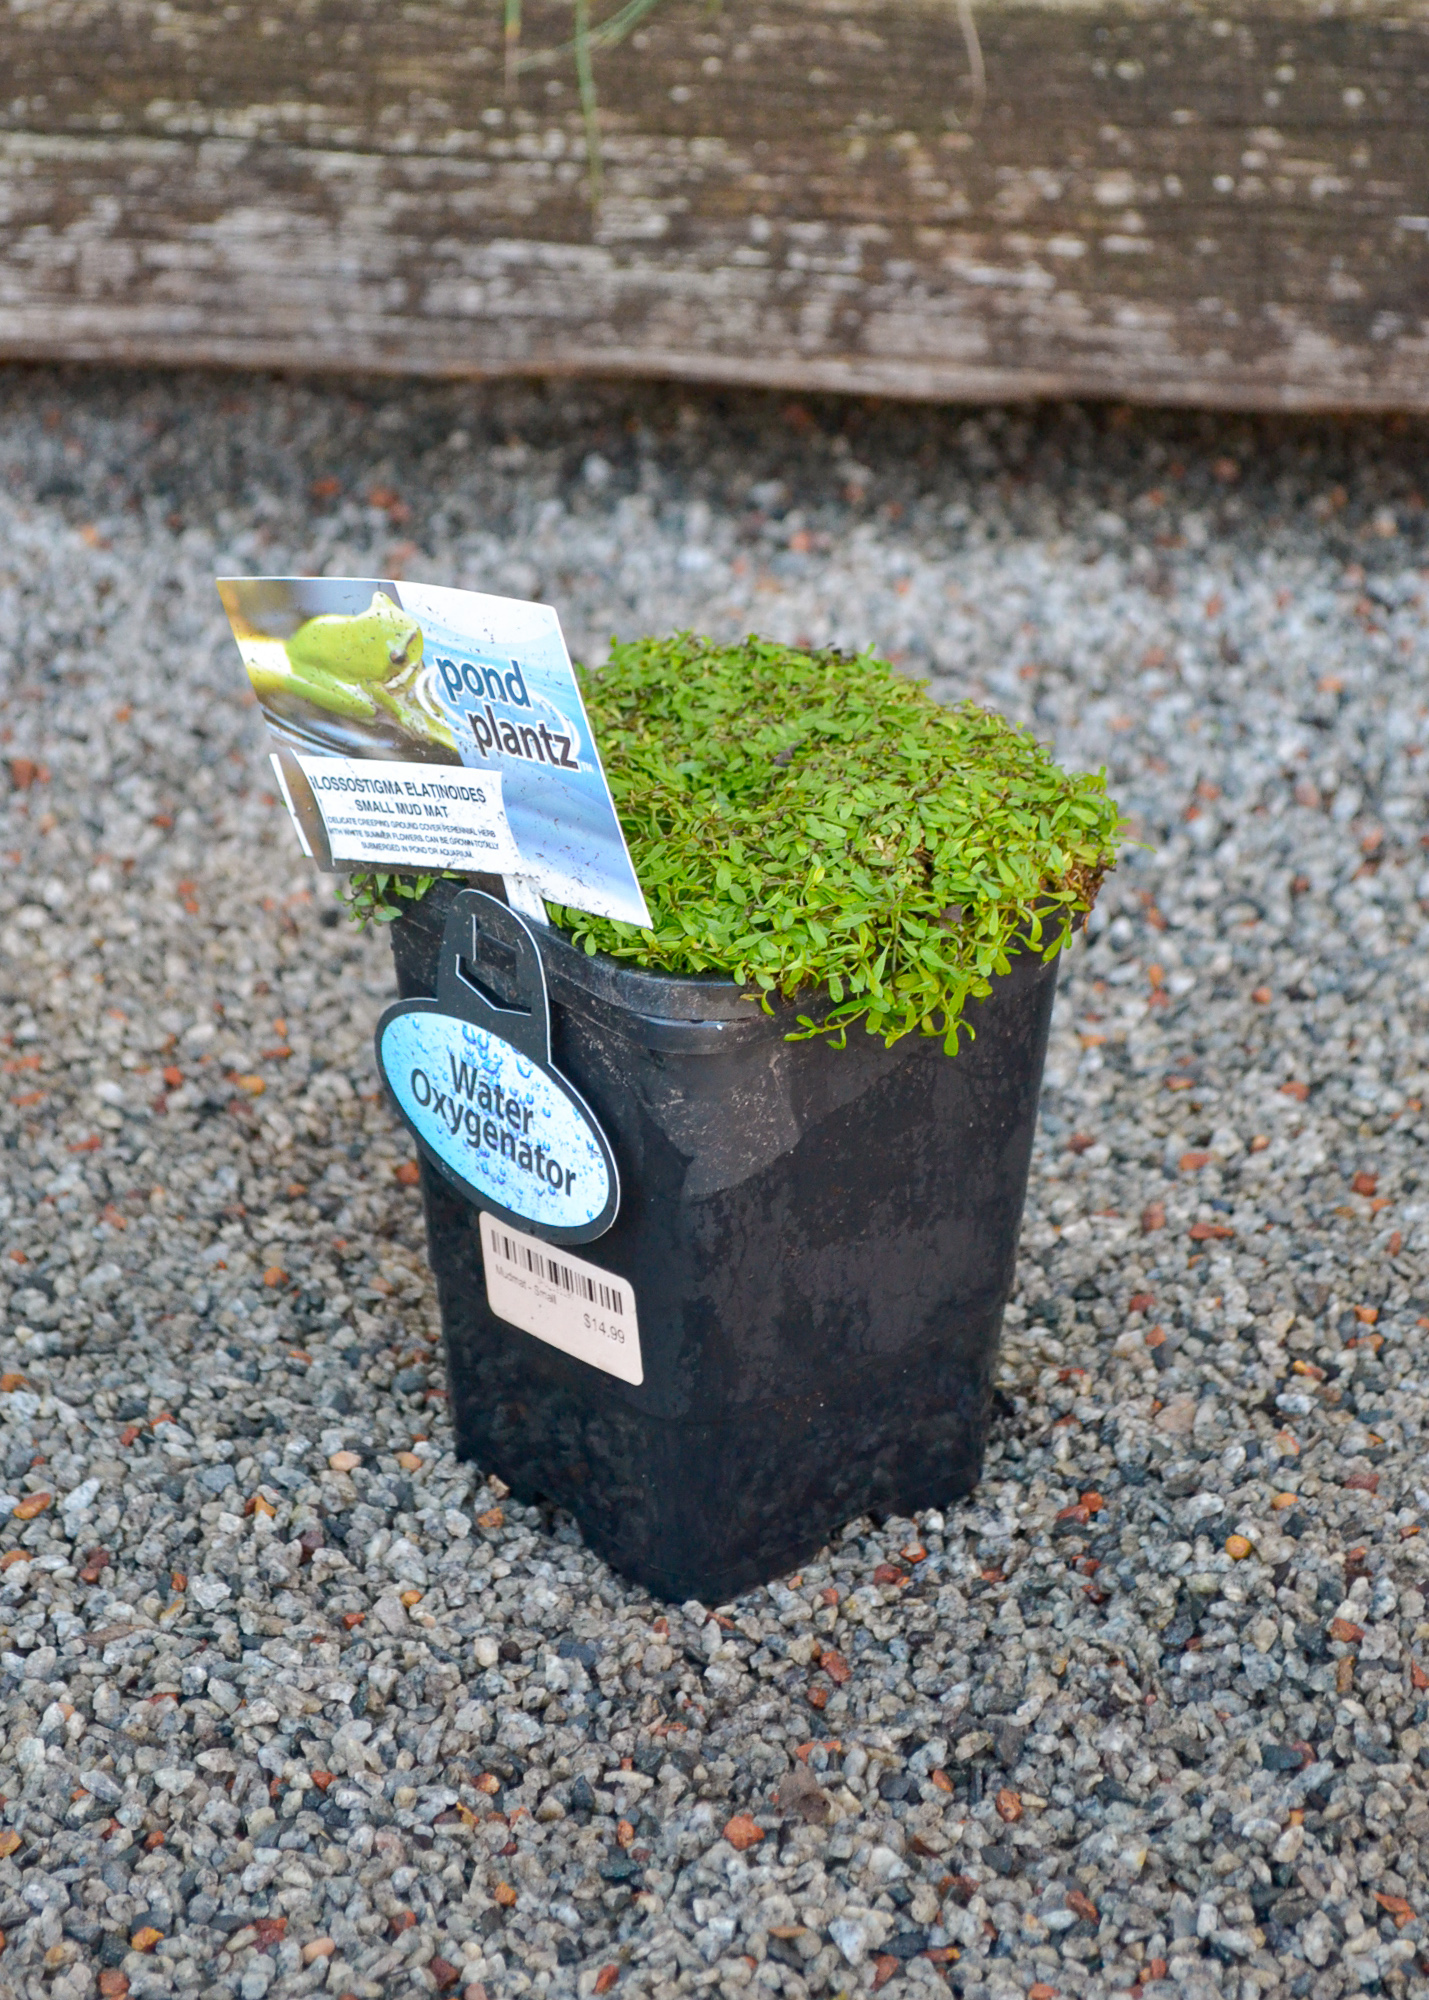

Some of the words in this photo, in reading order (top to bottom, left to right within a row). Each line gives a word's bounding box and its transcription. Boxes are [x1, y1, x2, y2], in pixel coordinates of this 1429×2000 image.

[435, 657, 532, 708] pond
[467, 704, 580, 770] plantz
[404, 781, 486, 802] ELATINOIDES
[354, 799, 395, 814] SMALL
[396, 803, 423, 816] MUD
[424, 805, 449, 818] MAT
[327, 816, 357, 825] DELICATE
[357, 818, 389, 828] CREEPING
[390, 820, 418, 830] GROUND
[419, 822, 442, 832] COVER
[360, 841, 401, 852] SUBMERGED
[409, 845, 428, 854] POND
[428, 847, 439, 855] OR
[424, 834, 439, 844] CAN
[439, 836, 449, 845] BE
[449, 1051, 534, 1135] Water
[410, 1067, 577, 1198] Oxygenator
[583, 1313, 625, 1344] $14.99
